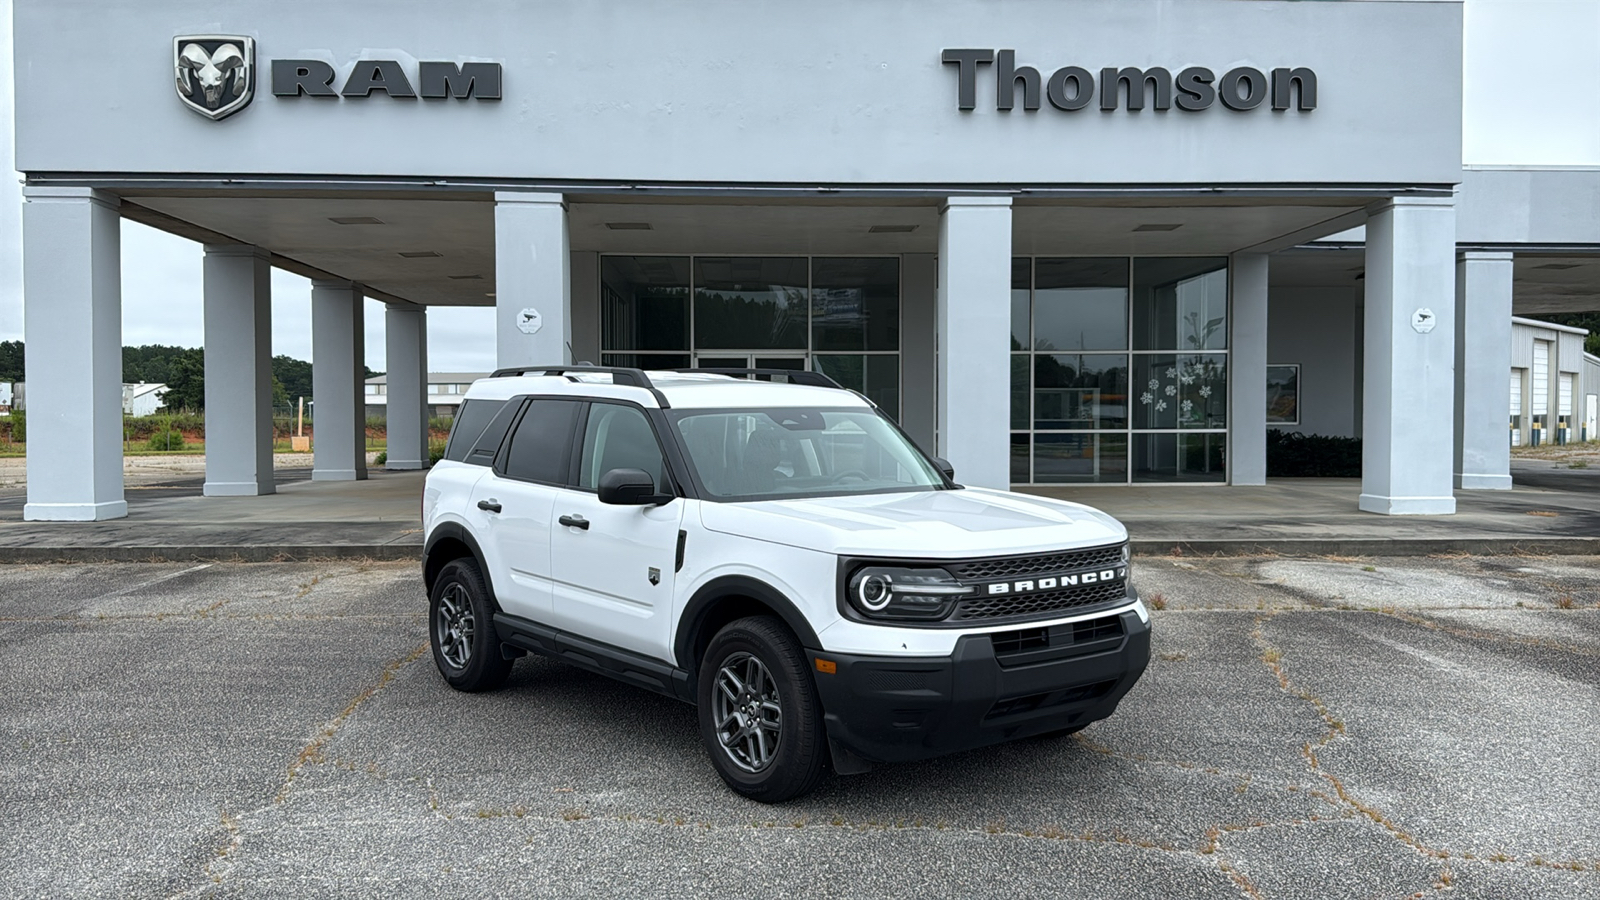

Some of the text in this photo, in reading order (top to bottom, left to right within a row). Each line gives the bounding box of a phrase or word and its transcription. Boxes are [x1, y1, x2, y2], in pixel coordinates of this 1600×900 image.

[271, 59, 502, 99] RAM
[941, 48, 1318, 112] Thomson
[988, 570, 1115, 595] BRONCO
